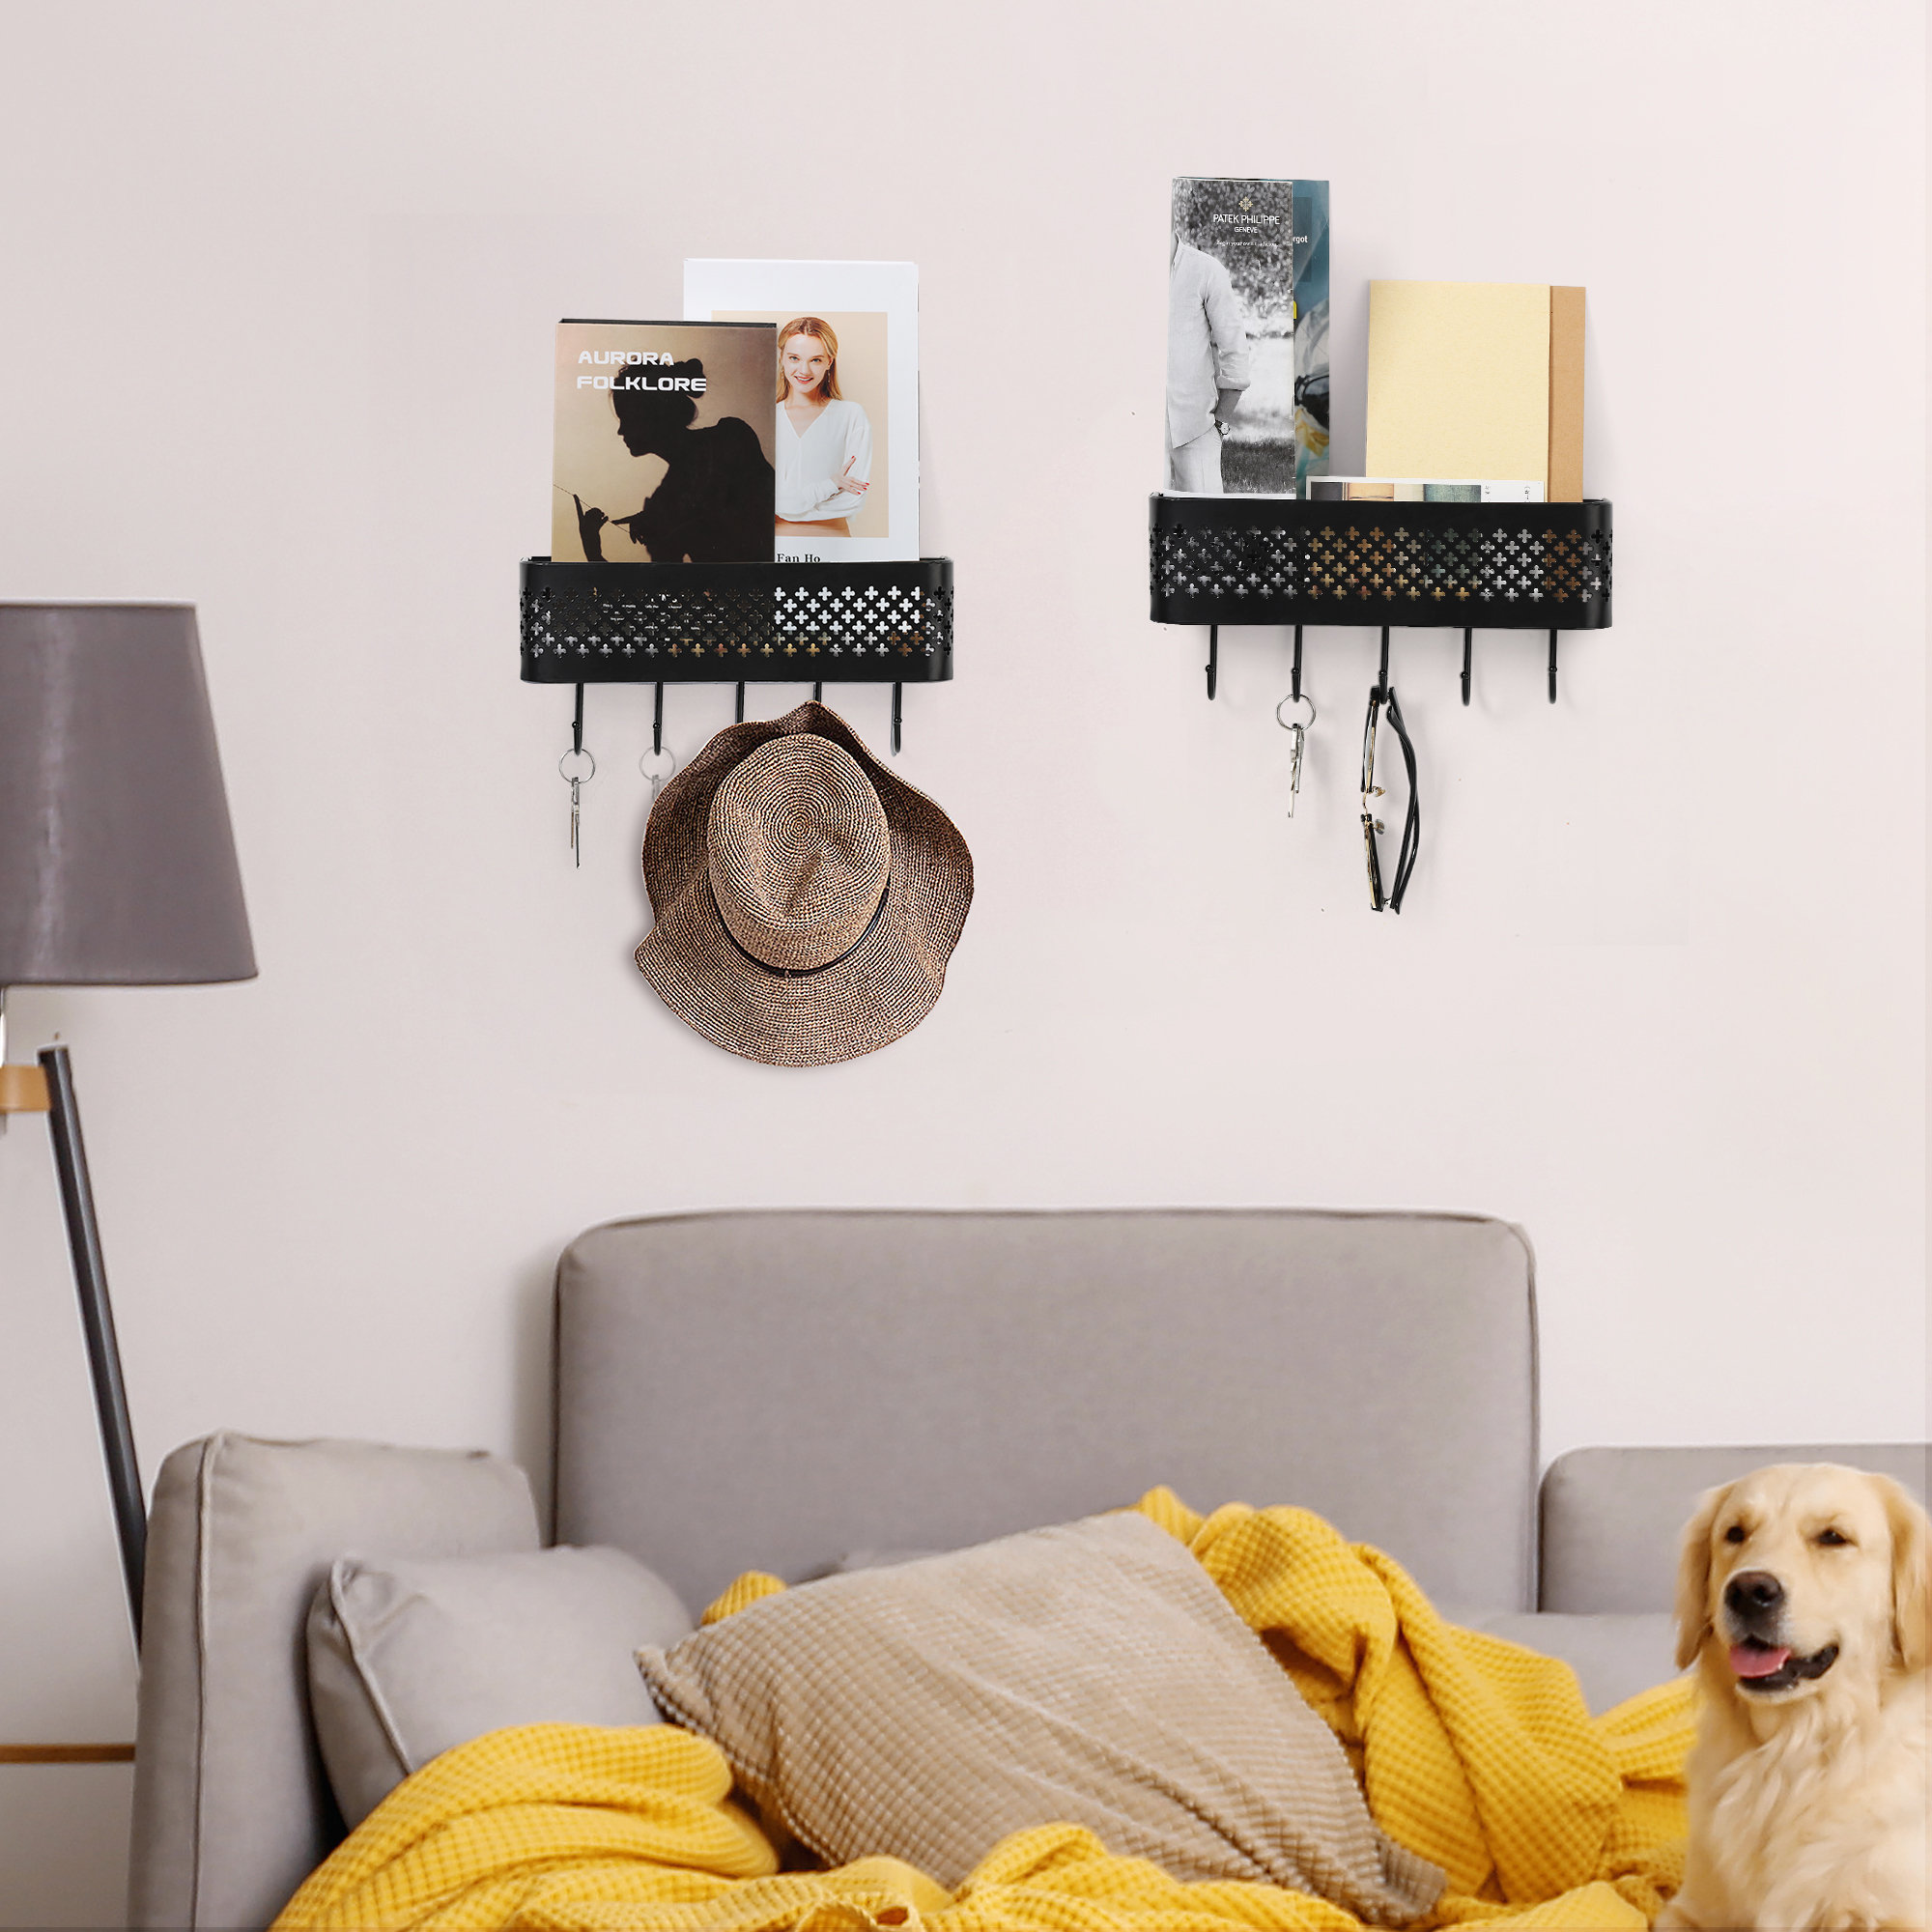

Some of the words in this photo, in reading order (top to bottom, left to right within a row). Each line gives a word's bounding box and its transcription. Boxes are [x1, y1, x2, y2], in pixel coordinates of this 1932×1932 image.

[1213, 214, 1239, 224] PATEK
[1241, 215, 1280, 225] PHILIPPE
[578, 351, 674, 366] AURORA
[577, 376, 707, 392] FOLKLORE
[777, 554, 800, 563] Fan
[805, 554, 821, 563] Ho
